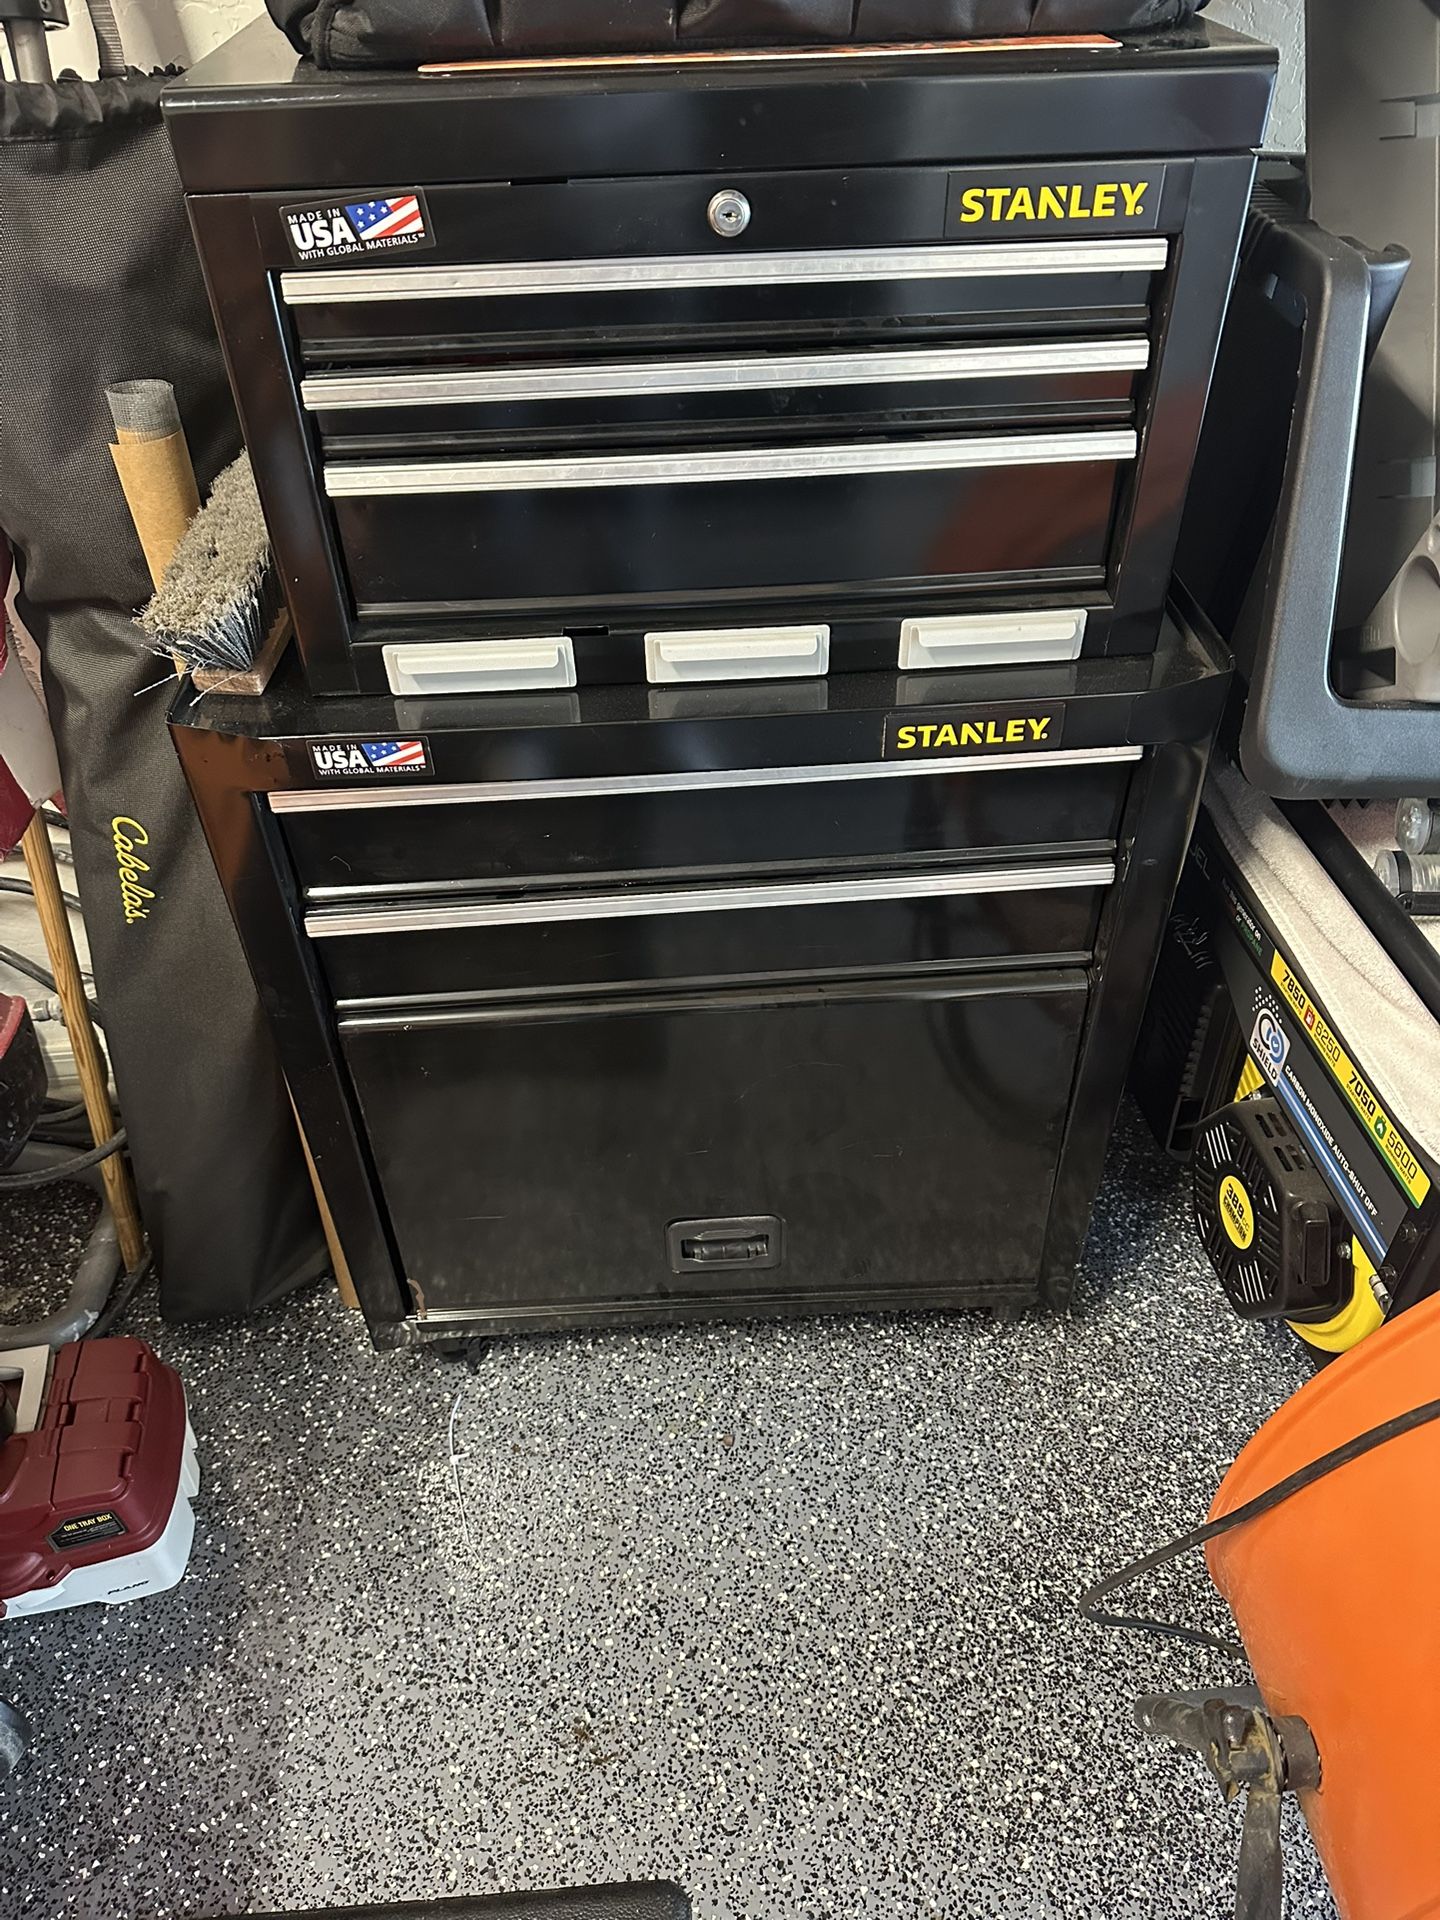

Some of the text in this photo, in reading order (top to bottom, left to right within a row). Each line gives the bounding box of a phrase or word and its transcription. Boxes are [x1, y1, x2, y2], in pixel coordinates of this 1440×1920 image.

[287, 208, 340, 225] MADE IN
[290, 216, 357, 251] USA
[298, 248, 325, 261] WITH
[327, 243, 364, 257] GLOBAL
[897, 717, 1051, 749] STANLEY
[346, 743, 357, 751] IN
[314, 749, 368, 769] USA
[318, 768, 341, 776] WITH
[343, 767, 374, 775] GLOBAL
[1282, 970, 1341, 1062] 7850 6250
[1252, 1038, 1278, 1081] SHIELD
[1349, 1070, 1418, 1180] 7050 5600
[1360, 1104, 1372, 1124] WATTS
[1285, 1065, 1378, 1216] CARBON MONOXIDE AUTO-SHUT OFF
[1399, 1164, 1412, 1186] WATTS
[1226, 1183, 1244, 1219] 389
[63, 1524, 79, 1532] ONE
[79, 1518, 96, 1528] TRAY
[96, 1513, 112, 1523] BOX
